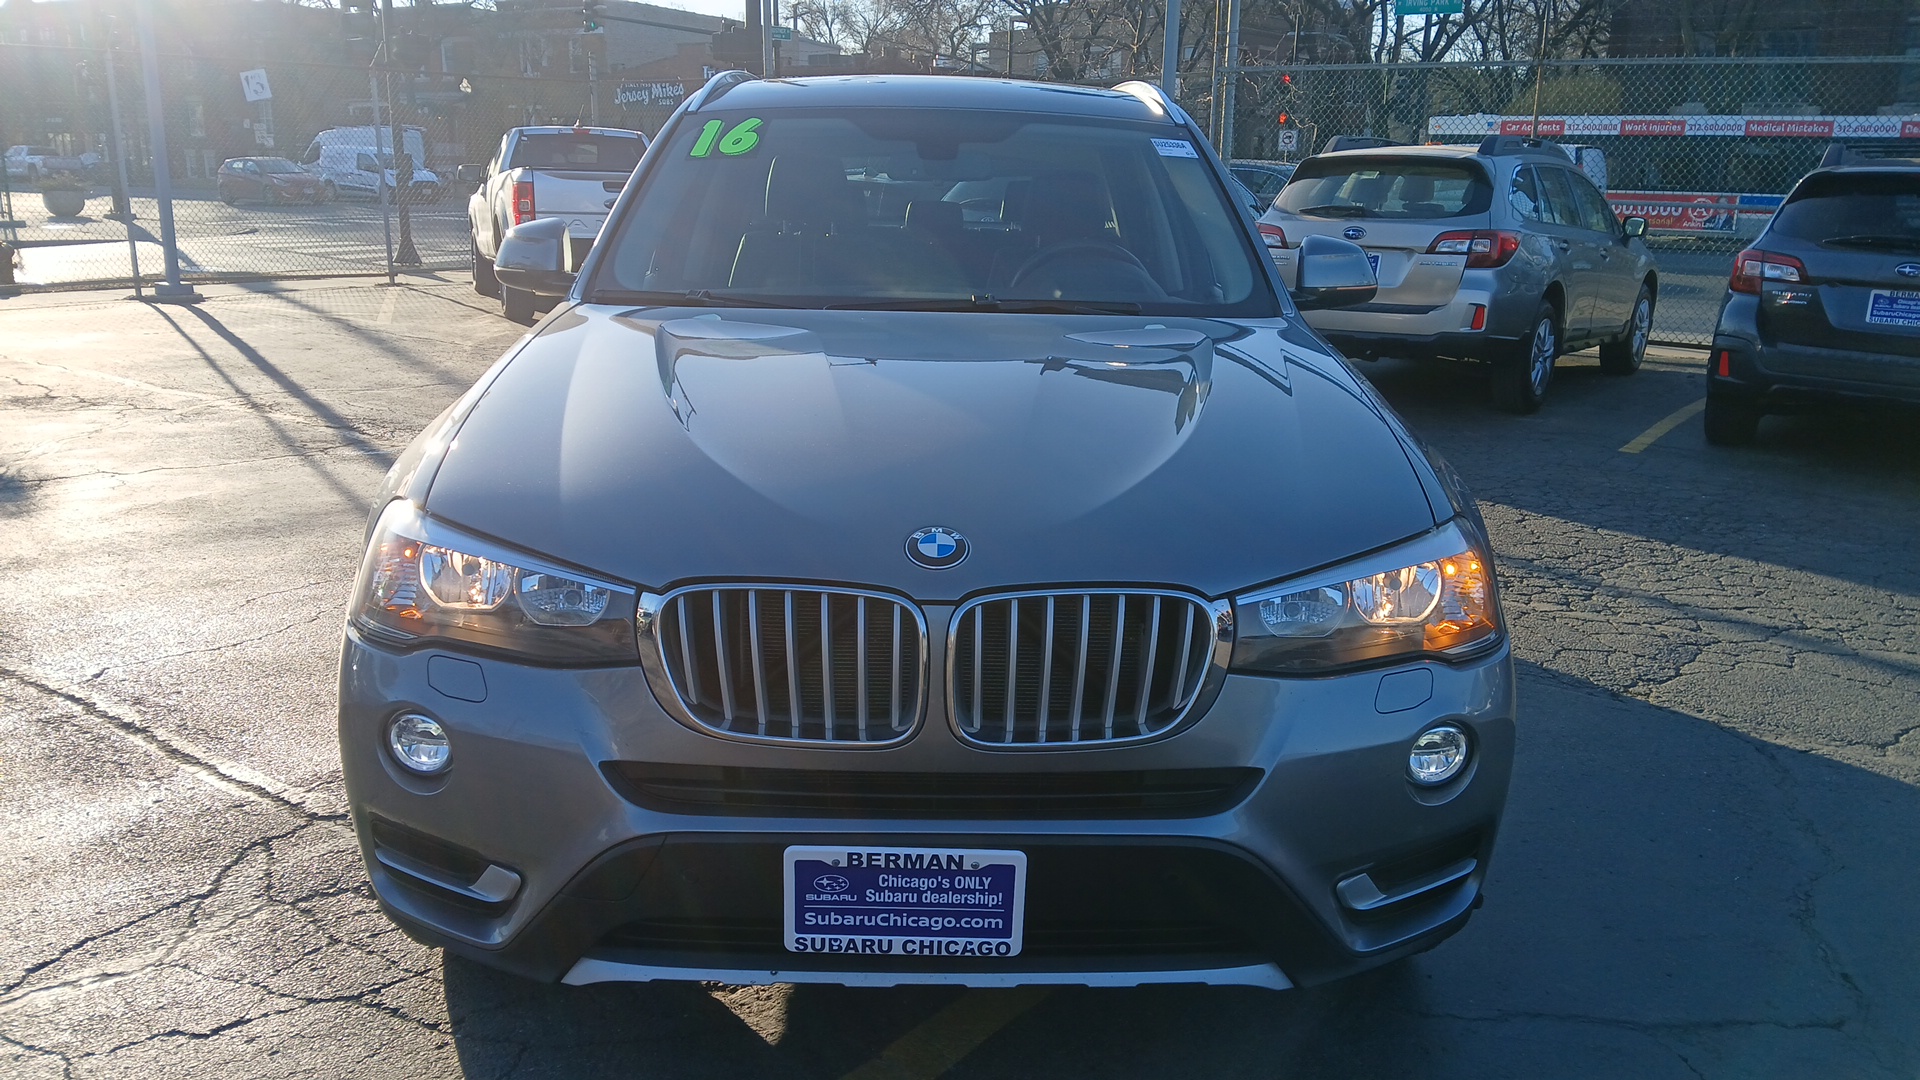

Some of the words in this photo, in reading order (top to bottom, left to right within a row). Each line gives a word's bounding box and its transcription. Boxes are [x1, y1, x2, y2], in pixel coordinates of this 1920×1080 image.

[614, 88, 649, 105] Jersey
[1506, 123, 1520, 131] Car
[1521, 122, 1561, 131] Acdents
[1625, 122, 1647, 131] Work
[1749, 123, 1785, 132] Medical
[1786, 123, 1830, 132] Mistakes
[690, 117, 764, 158] 16
[1890, 290, 1920, 298] BERMA
[912, 527, 964, 540] BMW
[846, 852, 965, 871] BERMAN
[878, 874, 951, 890] Chicago's
[954, 876, 992, 890] ONLY
[805, 893, 857, 901] SUBARU
[865, 889, 918, 903] Subaru
[921, 890, 1003, 908] dealership!
[804, 912, 1004, 931] SubaruChicago.com
[794, 937, 893, 954] SUBARU
[901, 938, 1012, 956] CHICAGO
